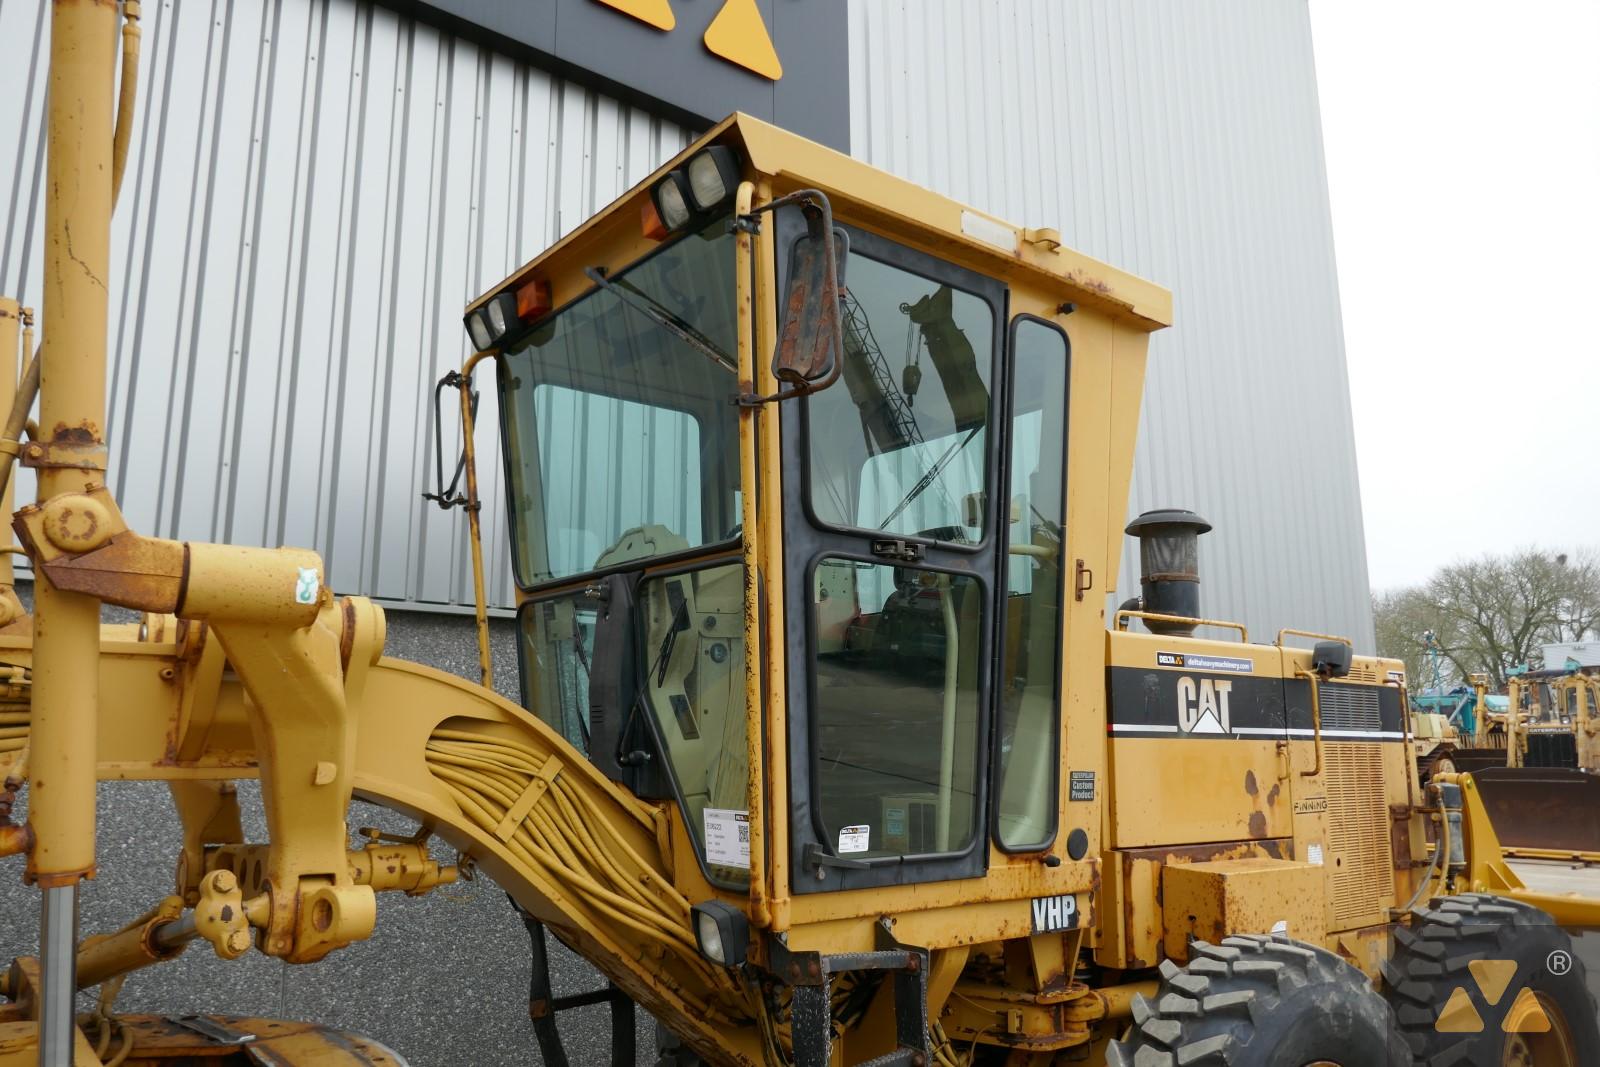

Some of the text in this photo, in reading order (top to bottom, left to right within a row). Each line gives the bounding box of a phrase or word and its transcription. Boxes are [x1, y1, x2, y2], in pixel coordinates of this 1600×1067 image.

[1159, 655, 1249, 670] DELTA deltaheavymachinery.com
[1177, 676, 1232, 733] CAT
[1072, 780, 1093, 789] Custom
[1071, 790, 1093, 799] Product
[1032, 895, 1076, 931] VHP
